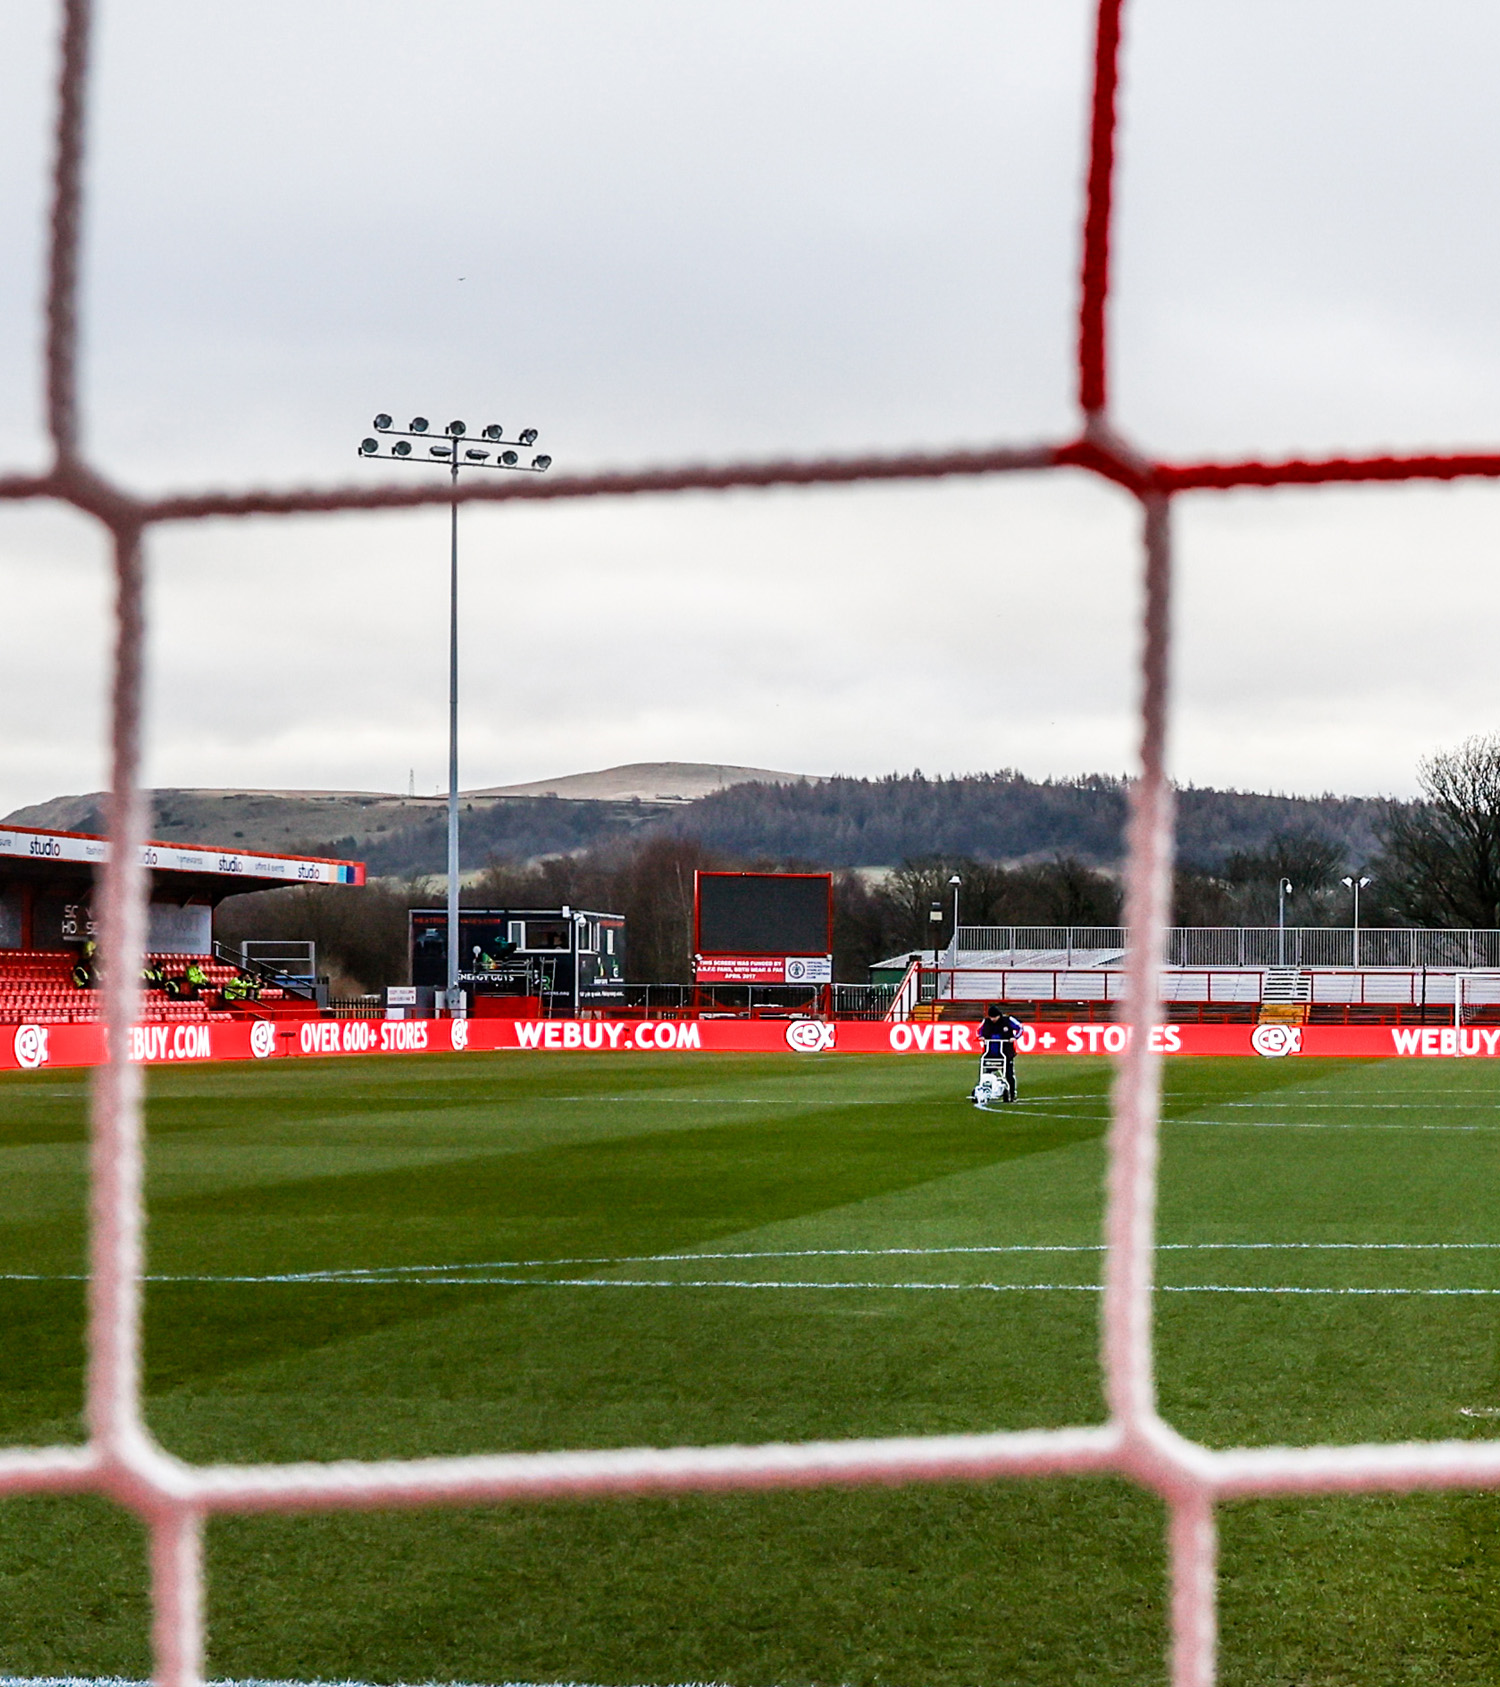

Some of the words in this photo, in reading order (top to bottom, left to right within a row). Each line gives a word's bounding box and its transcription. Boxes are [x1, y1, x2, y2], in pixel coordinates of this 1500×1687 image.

[30, 836, 60, 856] studio
[219, 855, 243, 873] studio
[298, 863, 319, 879] studio
[301, 1022, 340, 1052] OVER
[343, 1022, 377, 1051] 600+
[381, 1021, 428, 1050] STORES
[514, 1022, 700, 1049] WEBUY.COM
[890, 1024, 971, 1051] OVER
[1067, 1024, 1180, 1052] STOES
